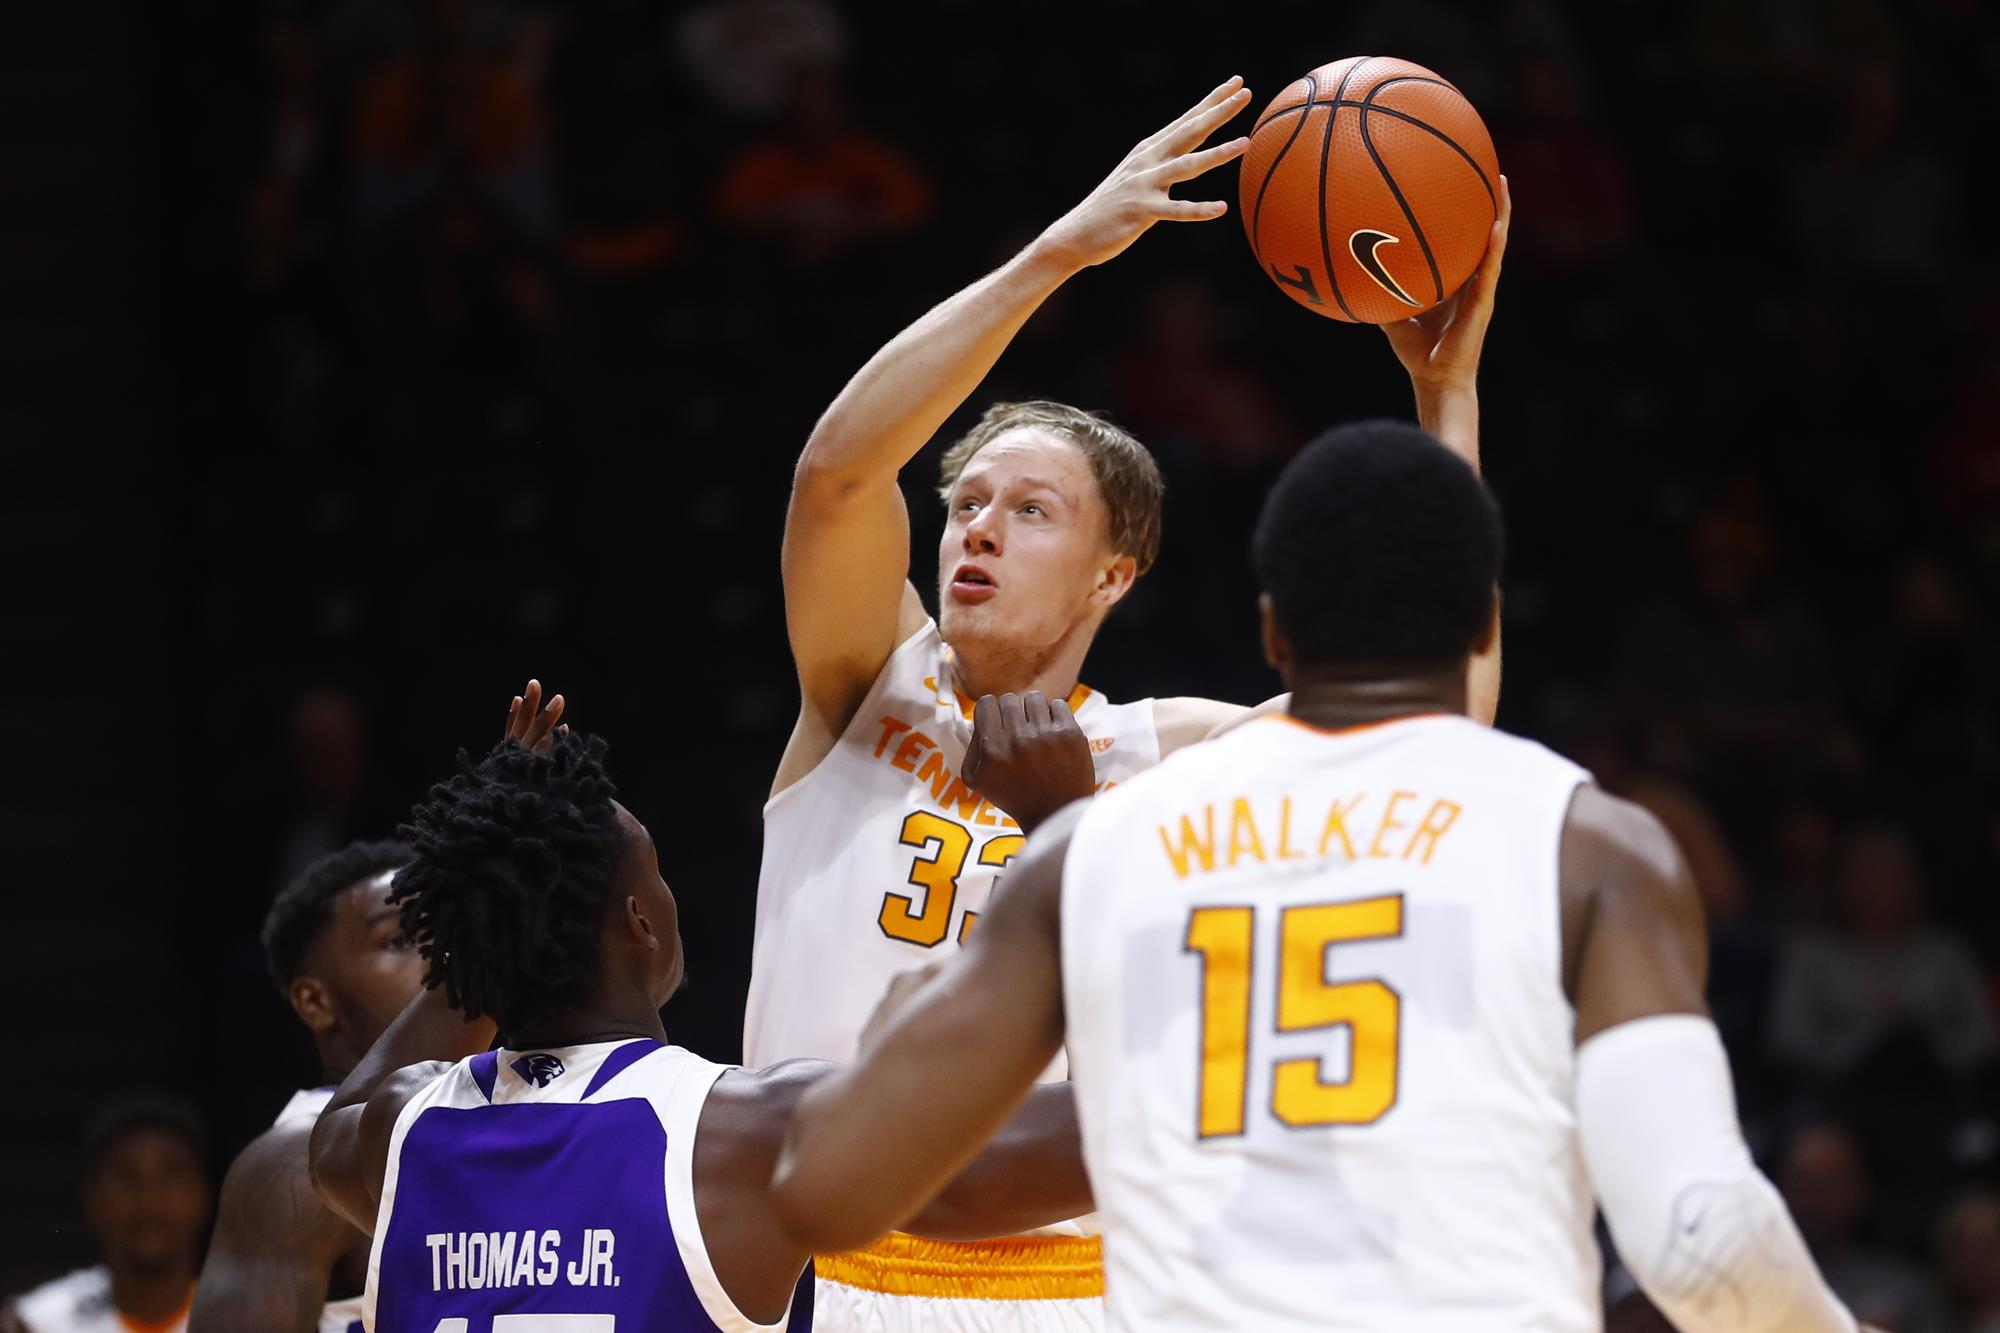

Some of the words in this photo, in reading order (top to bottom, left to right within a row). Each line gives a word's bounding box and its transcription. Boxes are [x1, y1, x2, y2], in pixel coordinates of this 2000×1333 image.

[872, 715, 1118, 828] TENNE
[1158, 791, 1461, 879] WALKER
[1182, 893, 1404, 1139] 15
[426, 1230, 561, 1291] THOMAS
[567, 1229, 621, 1288] JR.
